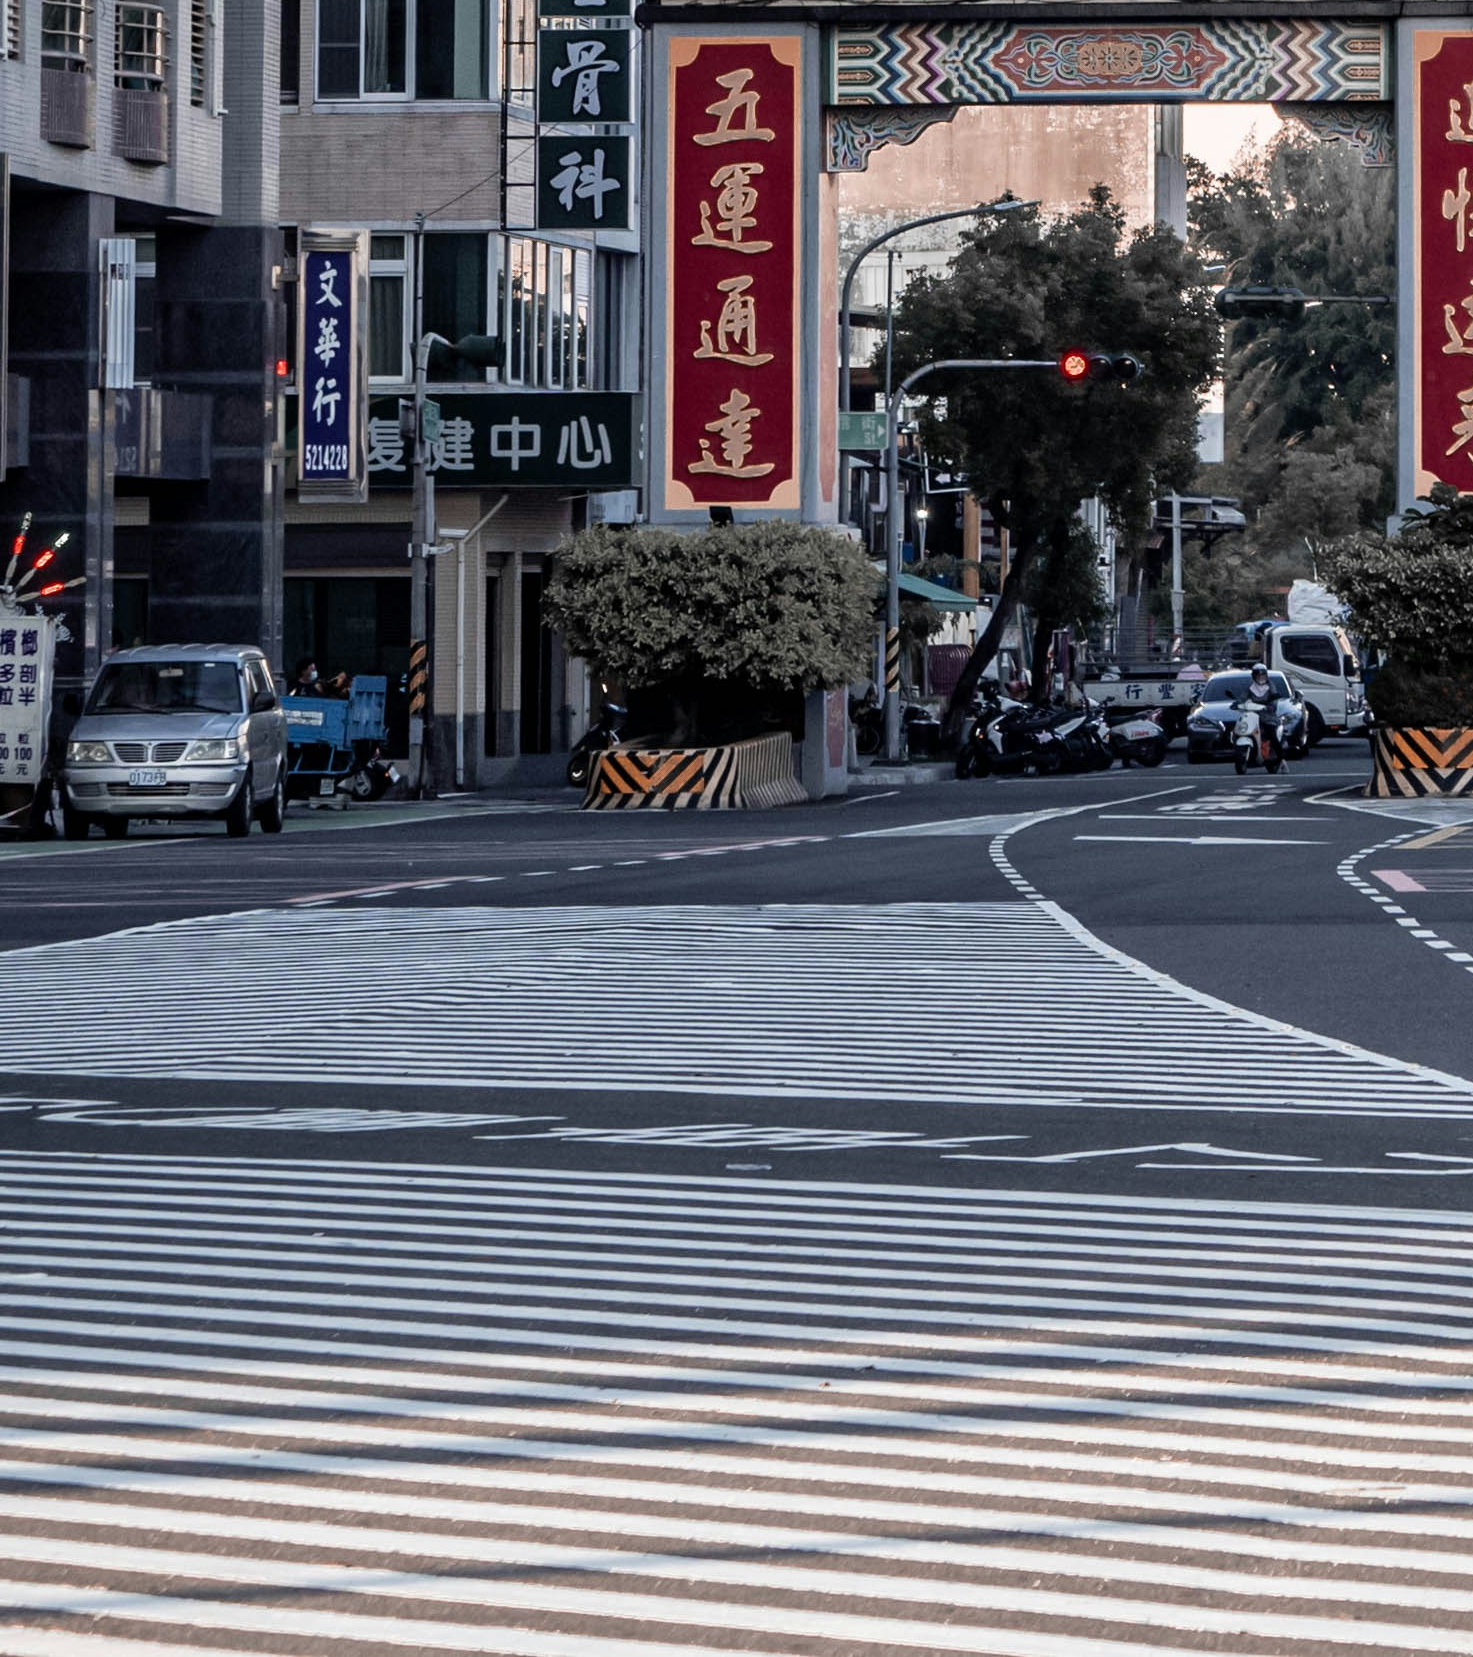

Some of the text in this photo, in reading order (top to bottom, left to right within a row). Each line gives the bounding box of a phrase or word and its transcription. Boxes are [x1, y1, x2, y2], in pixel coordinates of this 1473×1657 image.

[688, 68, 776, 479] 五運通達
[313, 260, 342, 427] 文華行
[305, 444, 348, 471] 5214228
[14, 747, 32, 761] 100
